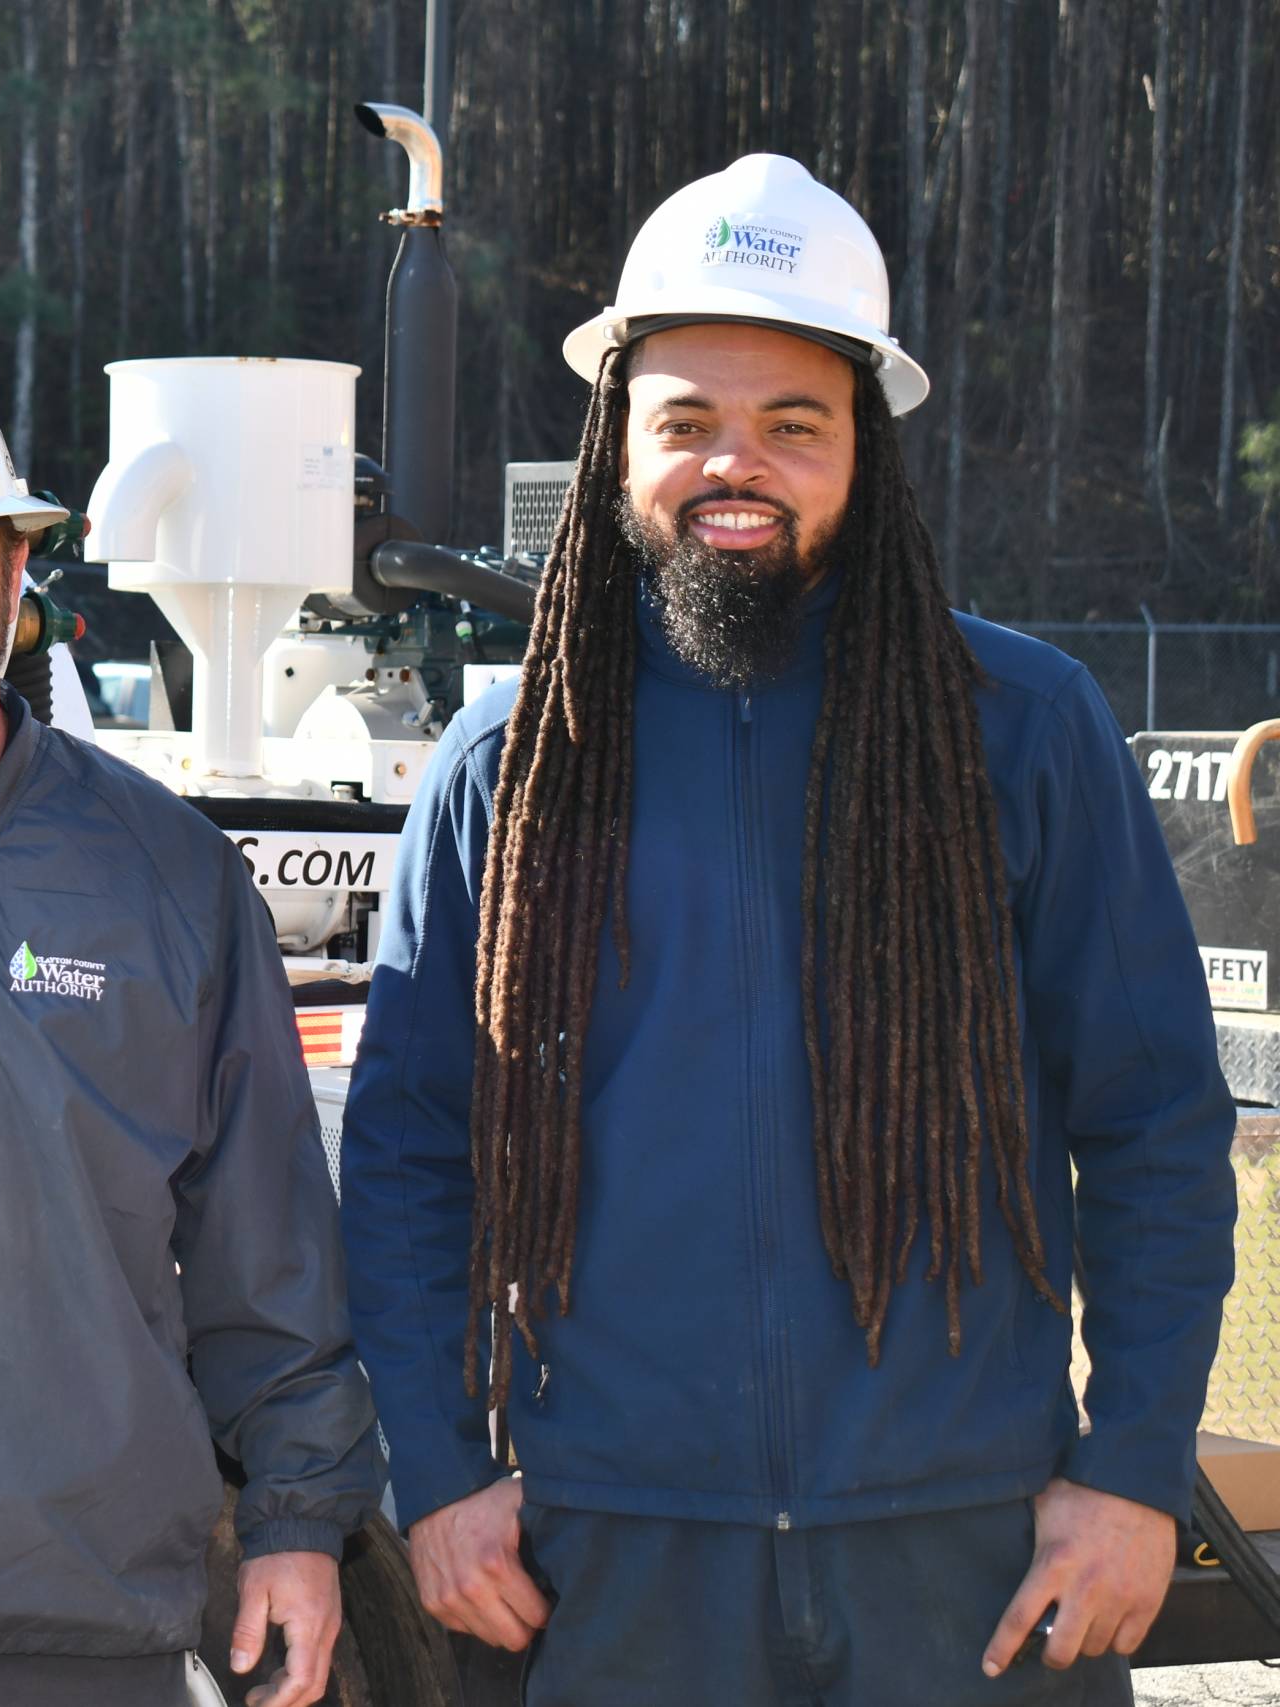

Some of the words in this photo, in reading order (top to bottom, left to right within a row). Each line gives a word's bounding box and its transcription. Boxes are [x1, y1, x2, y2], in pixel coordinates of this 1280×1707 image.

[733, 231, 801, 258] Water
[701, 250, 797, 274] AUTHORITY
[35, 956, 73, 965] CLAYTON
[73, 959, 106, 971] COUNTY
[38, 963, 106, 989] Water
[9, 979, 104, 1001] AUTHORITY
